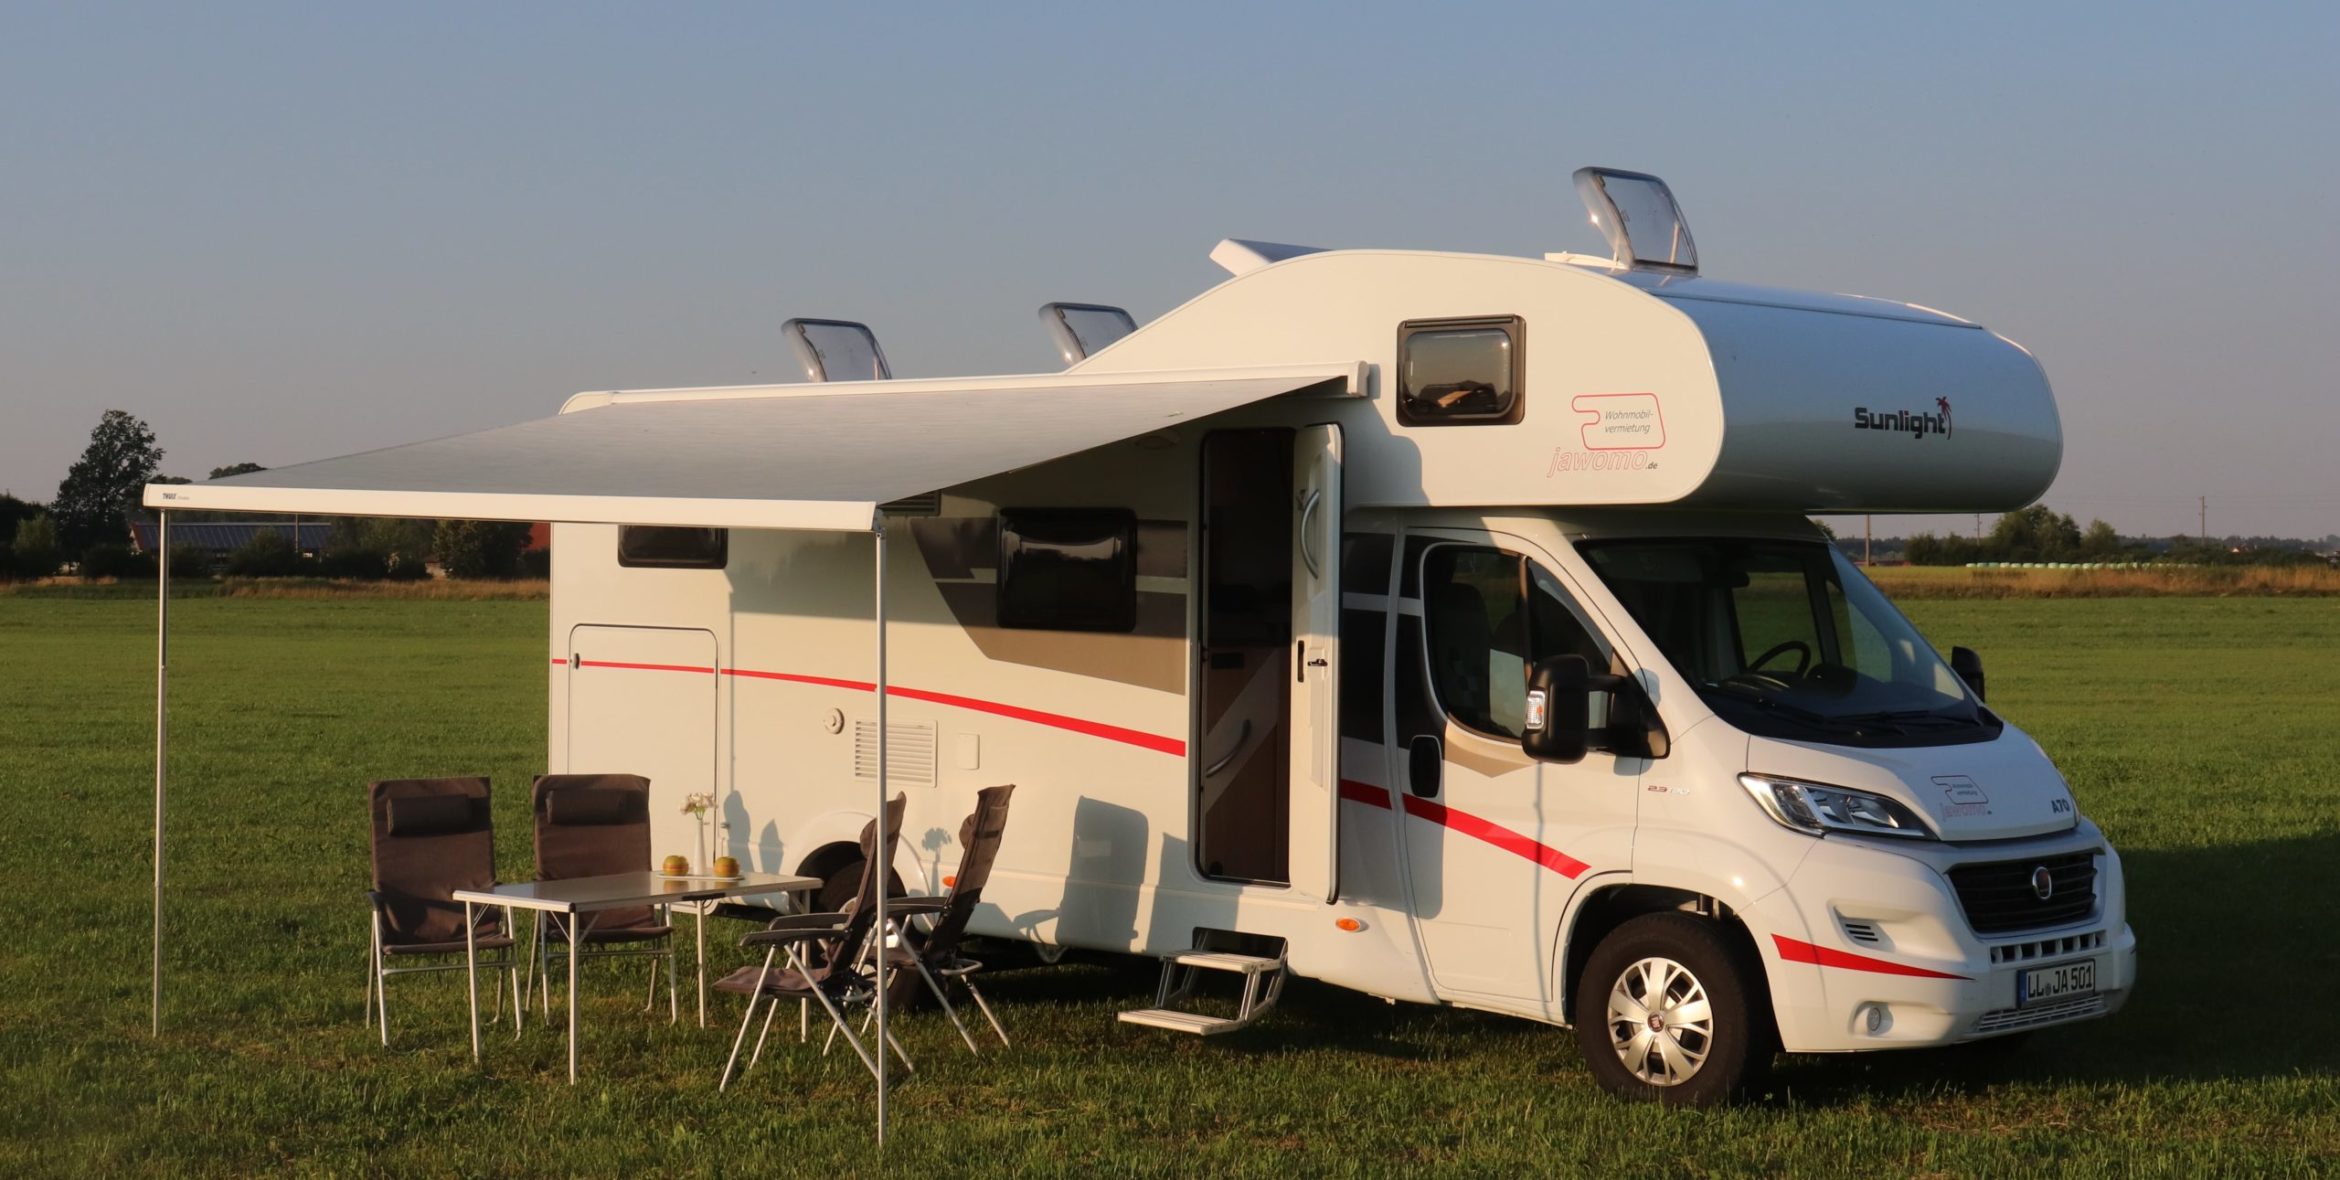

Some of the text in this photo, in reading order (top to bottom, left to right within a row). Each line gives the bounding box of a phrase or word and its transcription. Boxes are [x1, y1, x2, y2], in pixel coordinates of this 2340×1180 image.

[1605, 409, 1654, 421] Wohnmobil-
[1854, 406, 1947, 440] Sunlight
[1604, 423, 1651, 434] vermietung
[2050, 799, 2071, 815] A70
[2027, 965, 2093, 999] LL JA 501
